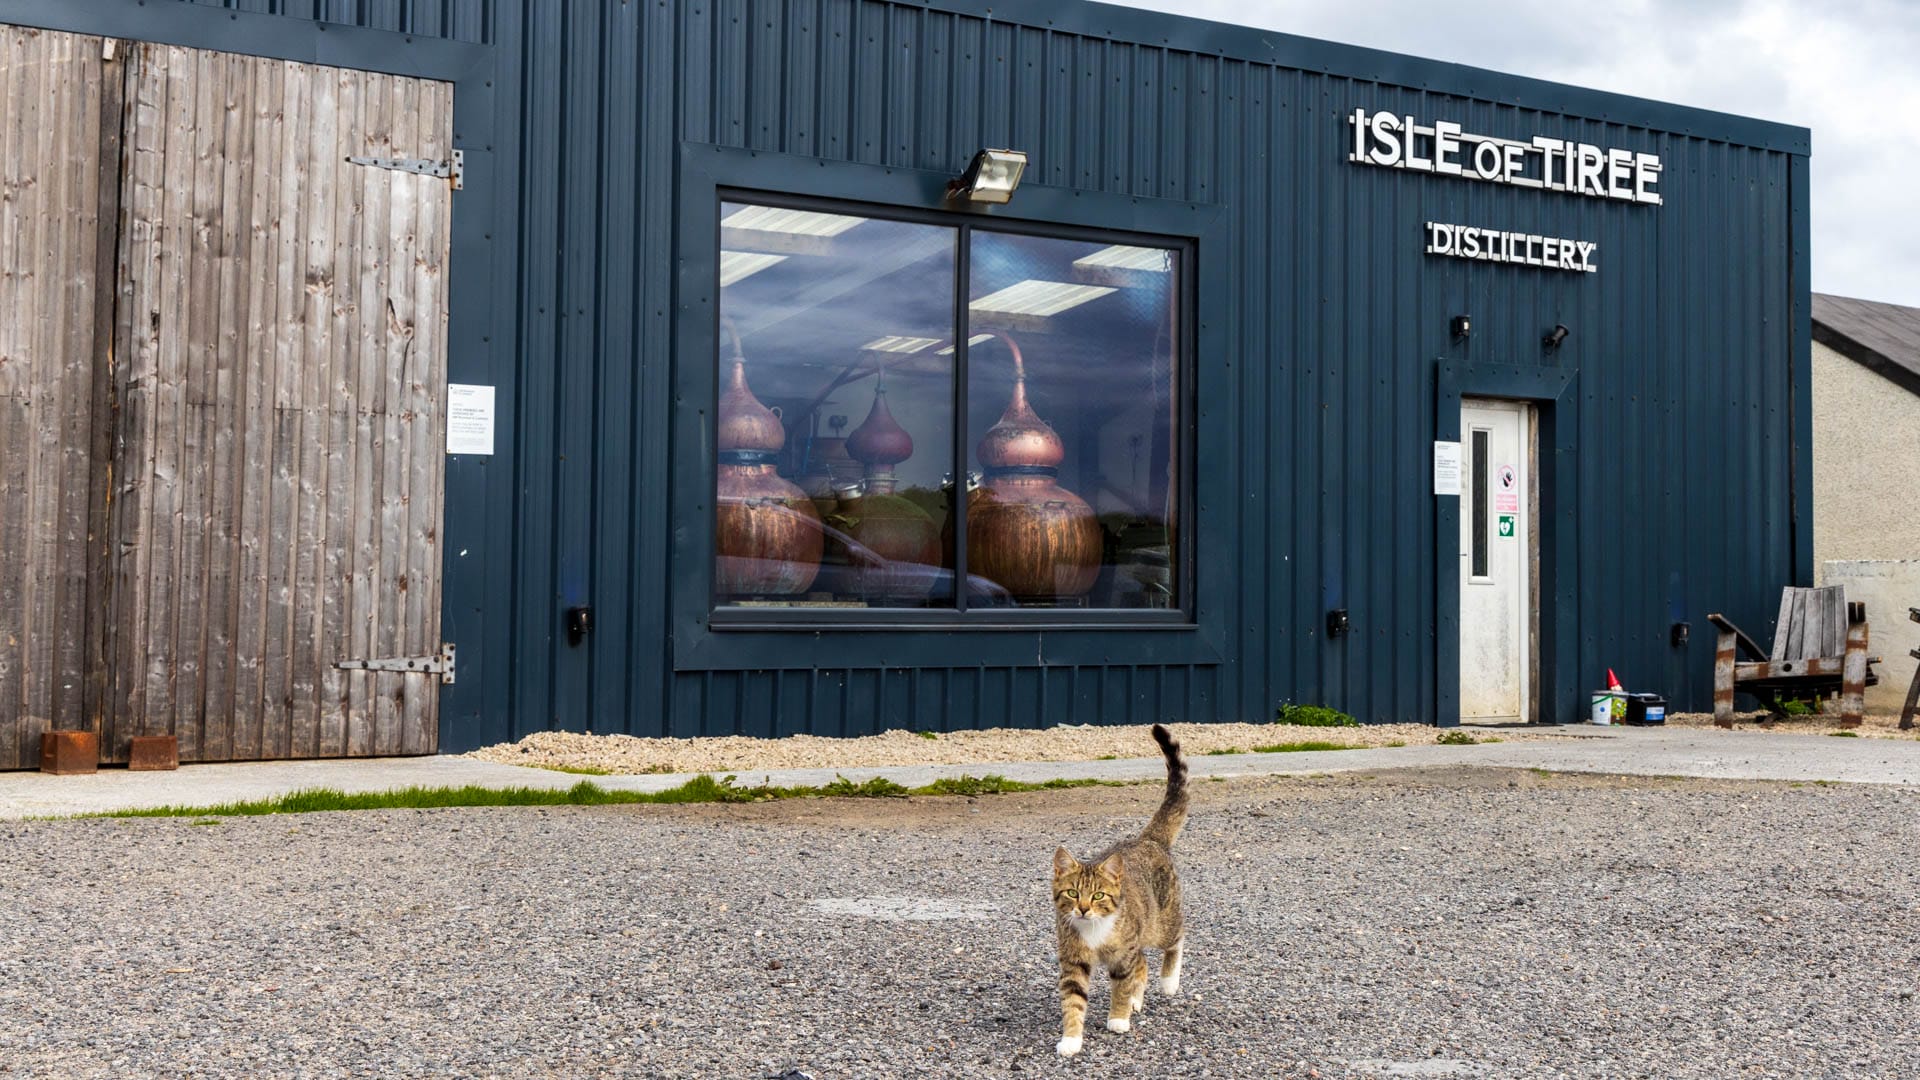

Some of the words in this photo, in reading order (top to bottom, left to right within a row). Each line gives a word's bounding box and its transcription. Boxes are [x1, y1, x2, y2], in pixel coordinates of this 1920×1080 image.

[1353, 108, 1462, 175] ISLE
[1474, 140, 1524, 182] OF
[1532, 136, 1660, 205] TIREE
[1431, 222, 1596, 272] DISTILLERY
